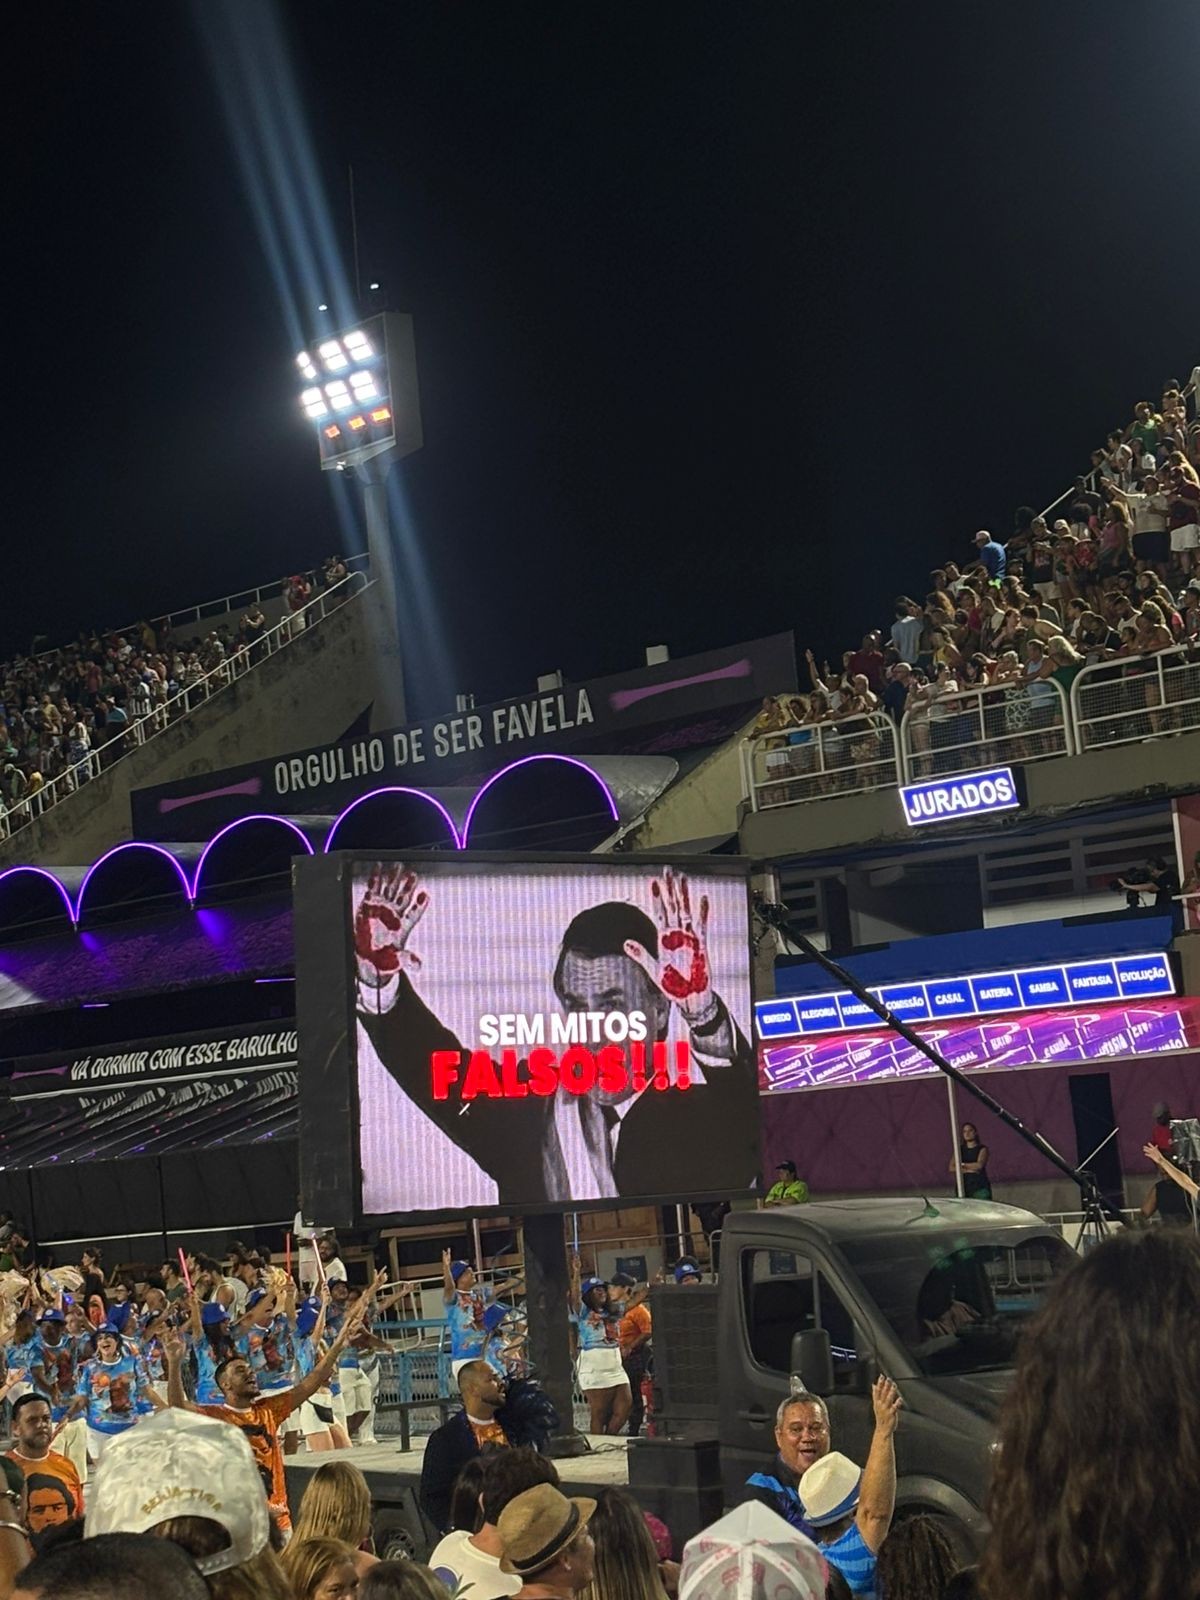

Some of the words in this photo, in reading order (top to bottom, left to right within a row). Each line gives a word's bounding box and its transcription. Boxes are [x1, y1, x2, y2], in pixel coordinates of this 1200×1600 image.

[275, 739, 385, 794] ORGULHO
[394, 728, 425, 767] DE
[434, 715, 484, 758] SER
[493, 689, 595, 744] FAVELA
[910, 778, 1012, 817] JURADOS
[1072, 975, 1113, 988] FANTASIA
[1120, 967, 1166, 983] EVOLUÇÃO
[979, 987, 1014, 999] BATERIA
[1029, 982, 1059, 993] SAMBA
[885, 996, 924, 1010] COMISSÃO
[935, 993, 965, 1005] CASAL
[801, 1007, 837, 1019] ALEGORIA
[479, 1013, 544, 1046] SEM
[550, 1010, 647, 1044] MITOS
[71, 1056, 92, 1080] VÁ
[91, 1051, 149, 1079] DORMIR
[150, 1046, 186, 1071] COM
[186, 1040, 227, 1066] ESSE
[226, 1031, 298, 1060] BARULHO
[430, 1040, 691, 1100] FALSOS!!!
